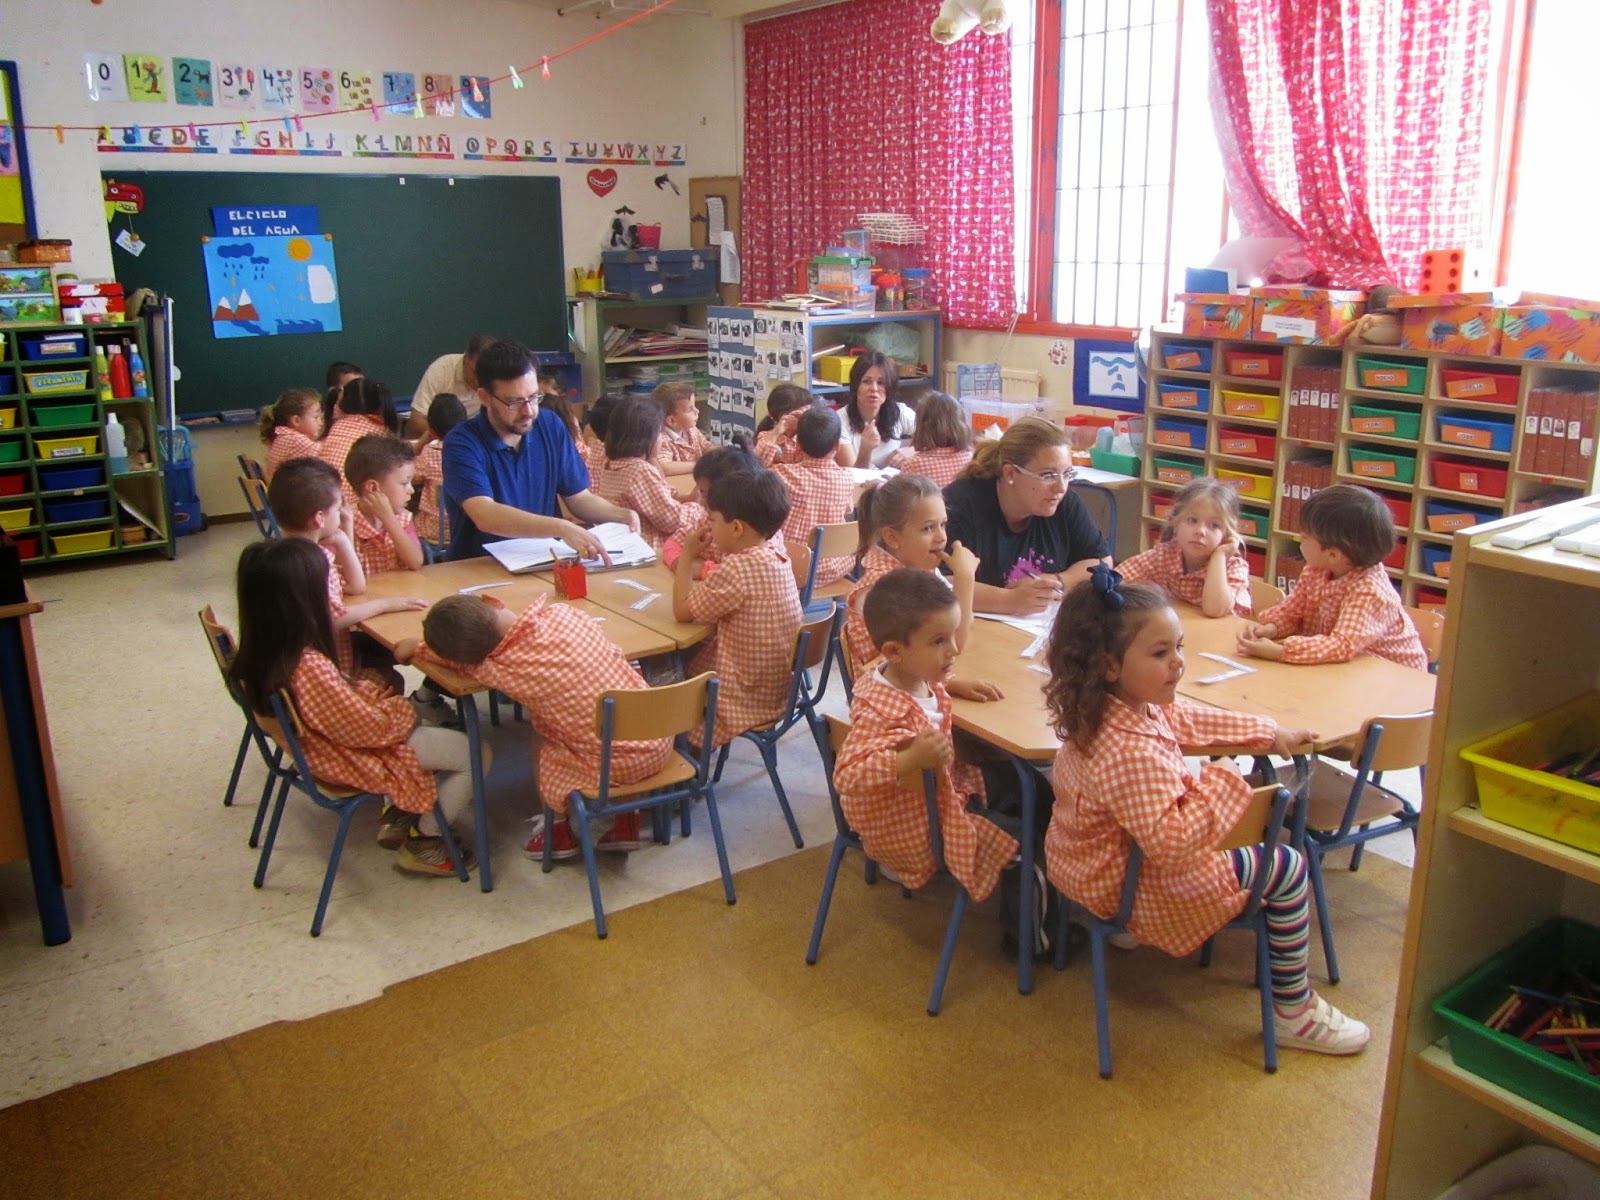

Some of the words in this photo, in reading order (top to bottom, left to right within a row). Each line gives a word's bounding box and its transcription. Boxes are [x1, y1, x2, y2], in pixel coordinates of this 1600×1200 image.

[98, 63, 110, 80] 0
[131, 62, 141, 78] 1
[179, 63, 191, 83] 2
[222, 68, 233, 86] 3
[263, 69, 274, 87] 4
[303, 72, 313, 89] 5
[341, 72, 351, 89] 6
[383, 75, 394, 92] 7
[425, 76, 434, 92] 8
[232, 226, 255, 236] DEL
[265, 225, 300, 235] AGUA
